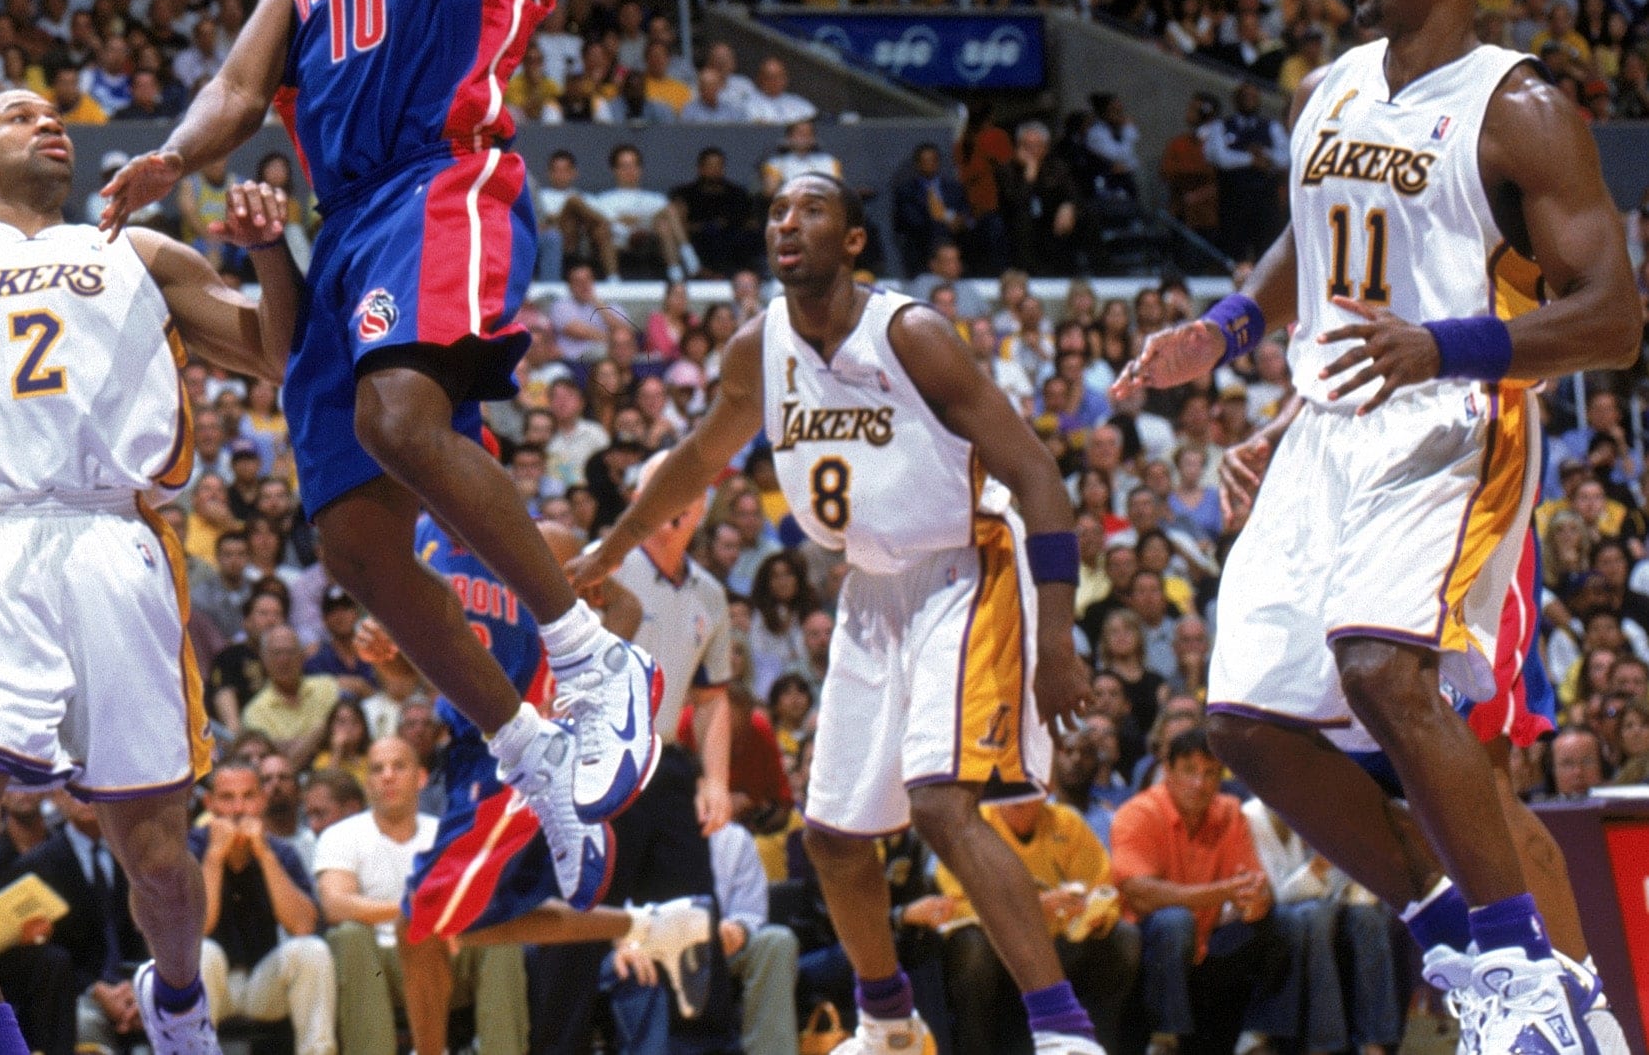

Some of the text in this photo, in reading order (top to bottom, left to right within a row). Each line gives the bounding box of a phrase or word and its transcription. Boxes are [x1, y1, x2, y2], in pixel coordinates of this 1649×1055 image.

[1301, 129, 1439, 197] LAKERS
[1326, 204, 1391, 307] 11
[7, 307, 69, 400] 2
[775, 400, 895, 452] LAKERS
[809, 455, 851, 531] 8
[451, 572, 520, 626] ROIT
